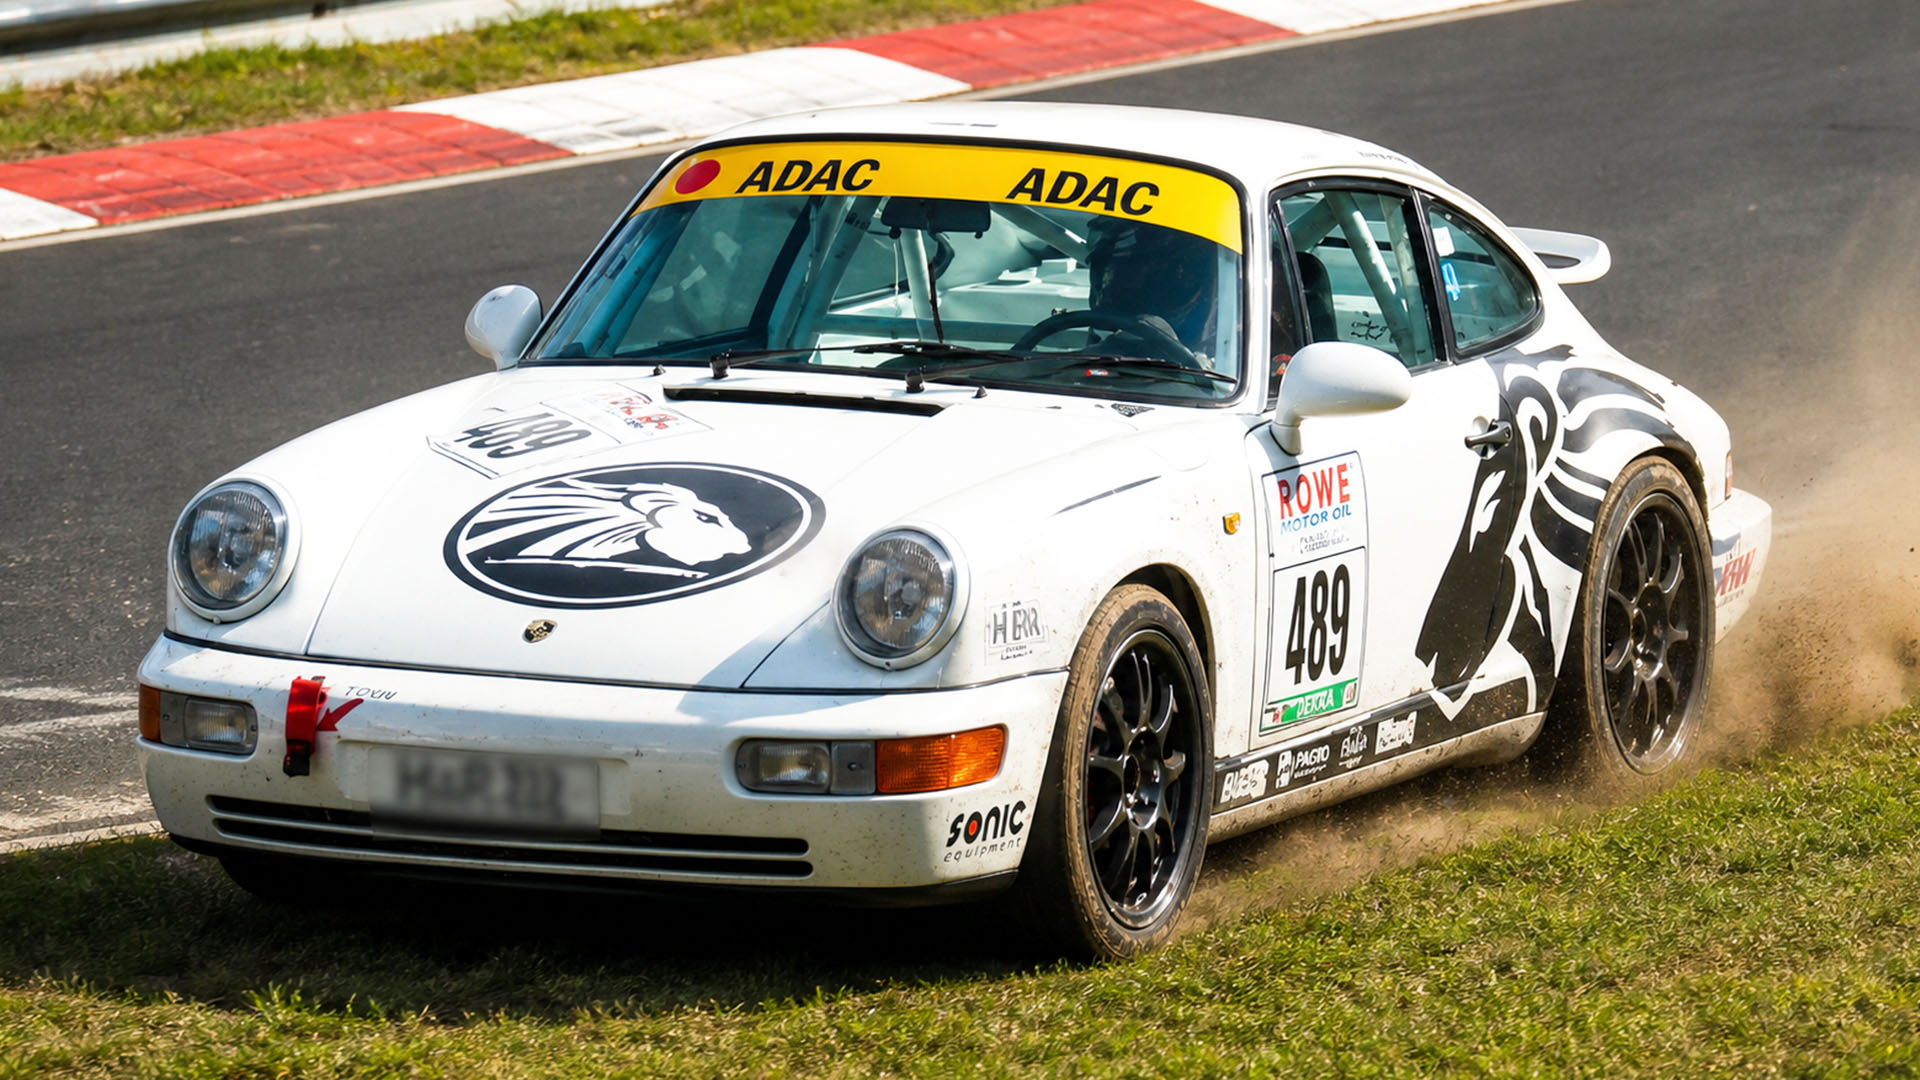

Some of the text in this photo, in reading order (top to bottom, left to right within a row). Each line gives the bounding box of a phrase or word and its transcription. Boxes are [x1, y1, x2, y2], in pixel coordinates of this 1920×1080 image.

[735, 158, 880, 194] ADAC
[1006, 167, 1160, 216] ADAC
[453, 412, 592, 459] 489
[1277, 463, 1351, 520] ROWE
[1281, 504, 1352, 535] MOTOR OIL
[1285, 563, 1351, 685] 489
[943, 837, 1022, 863] equipment
